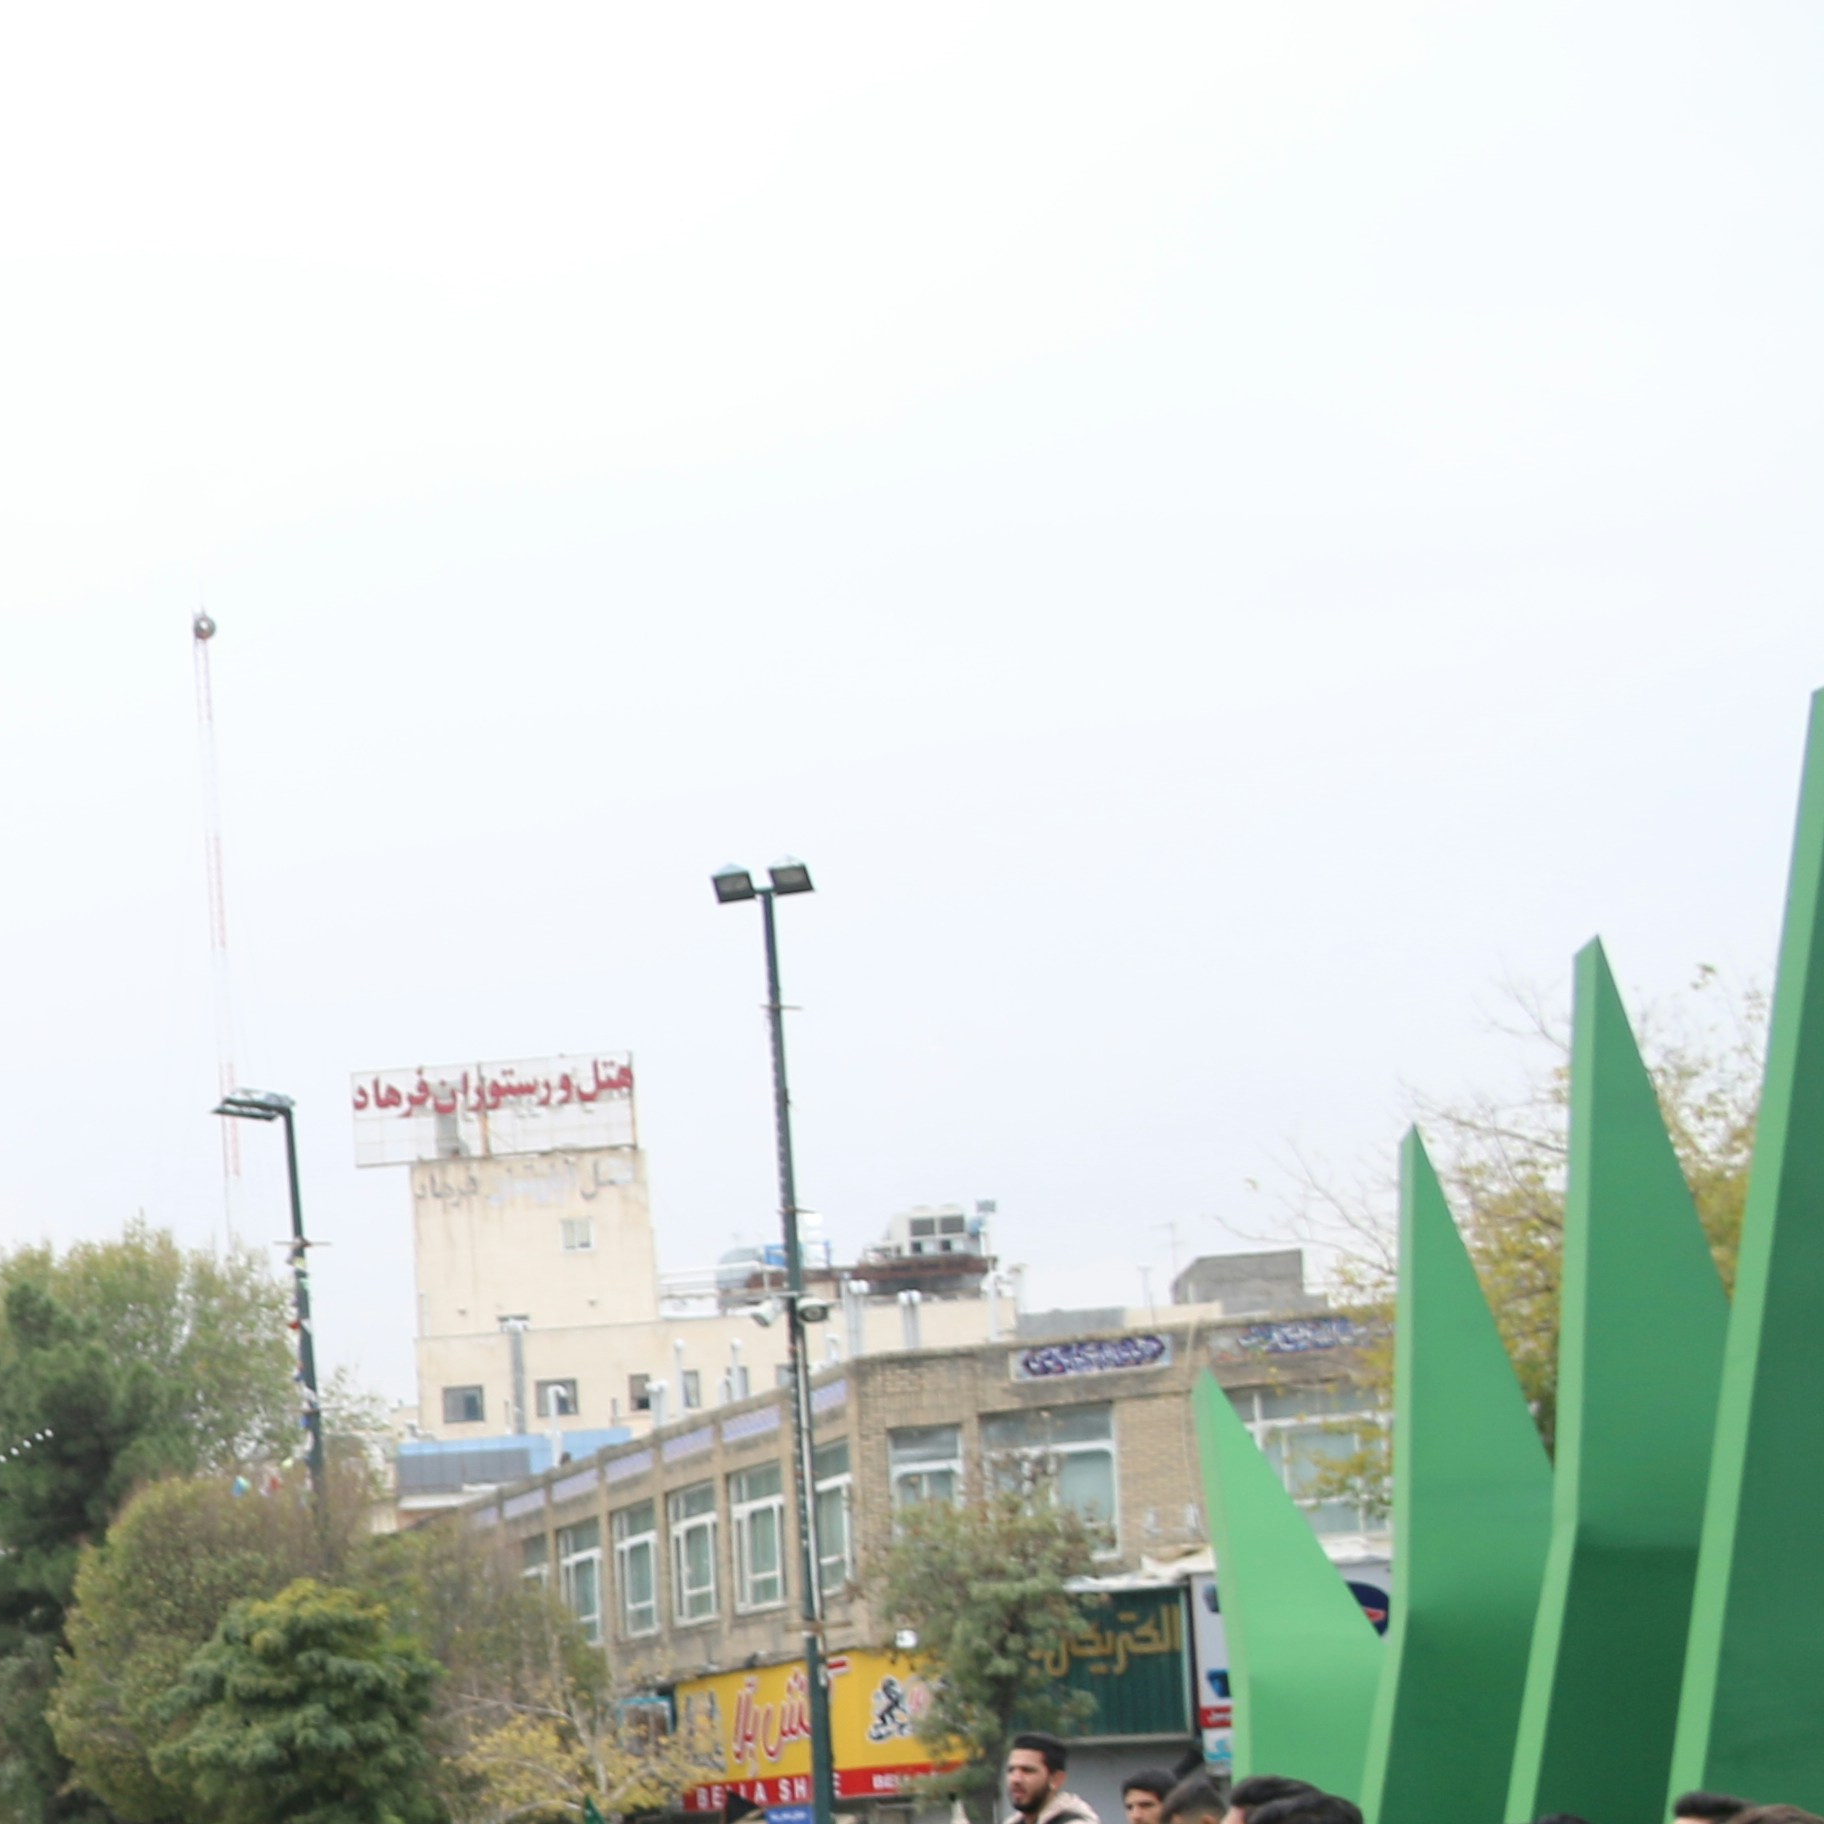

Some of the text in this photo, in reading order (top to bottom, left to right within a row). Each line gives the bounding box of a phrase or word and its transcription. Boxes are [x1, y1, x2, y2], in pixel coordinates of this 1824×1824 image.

[352, 1058, 633, 1119] هتل و رستوران فرهاد
[696, 1779, 769, 1810] BELA
[777, 1771, 841, 1803] SHE
